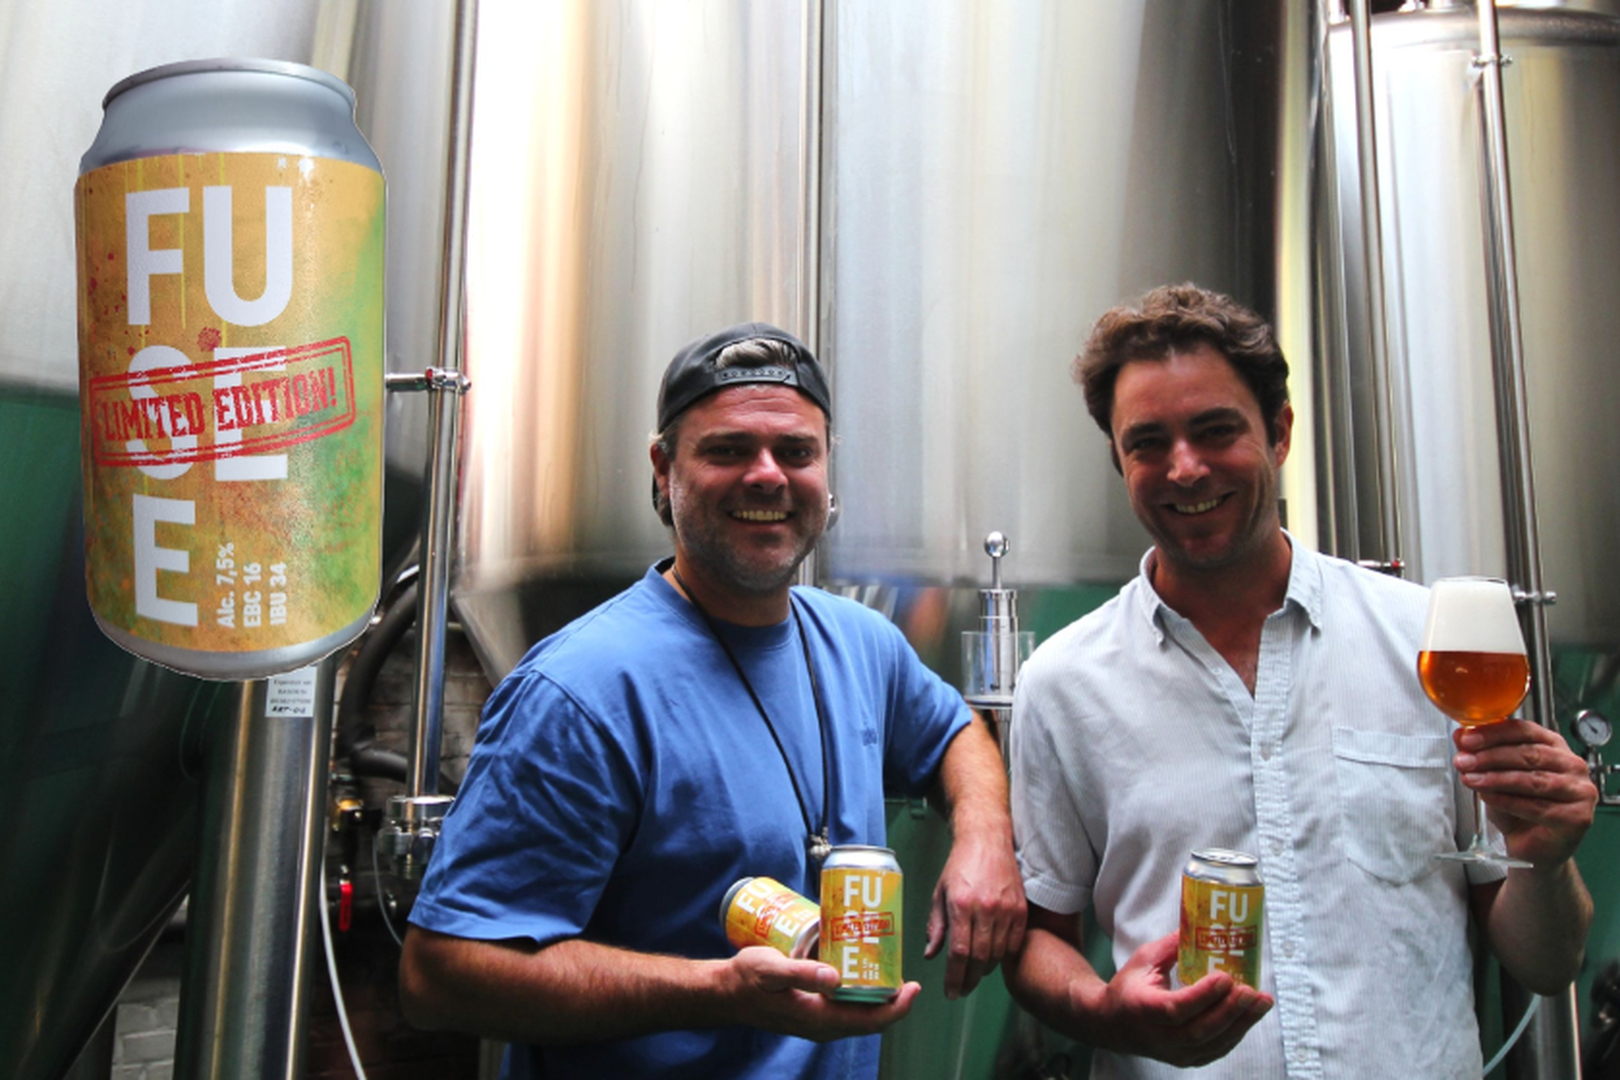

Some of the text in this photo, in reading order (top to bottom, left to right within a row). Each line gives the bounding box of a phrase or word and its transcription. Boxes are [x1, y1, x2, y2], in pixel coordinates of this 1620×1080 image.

[125, 185, 293, 327] FU
[102, 366, 338, 442] LIMITED EDITION!
[133, 493, 198, 627] E
[216, 541, 238, 629] Alc. 7,5%
[243, 562, 262, 628] EBC 16
[270, 562, 287, 626] IBU 34
[843, 875, 883, 908] FU
[1210, 890, 1249, 923] FU
[842, 946, 860, 980] E
